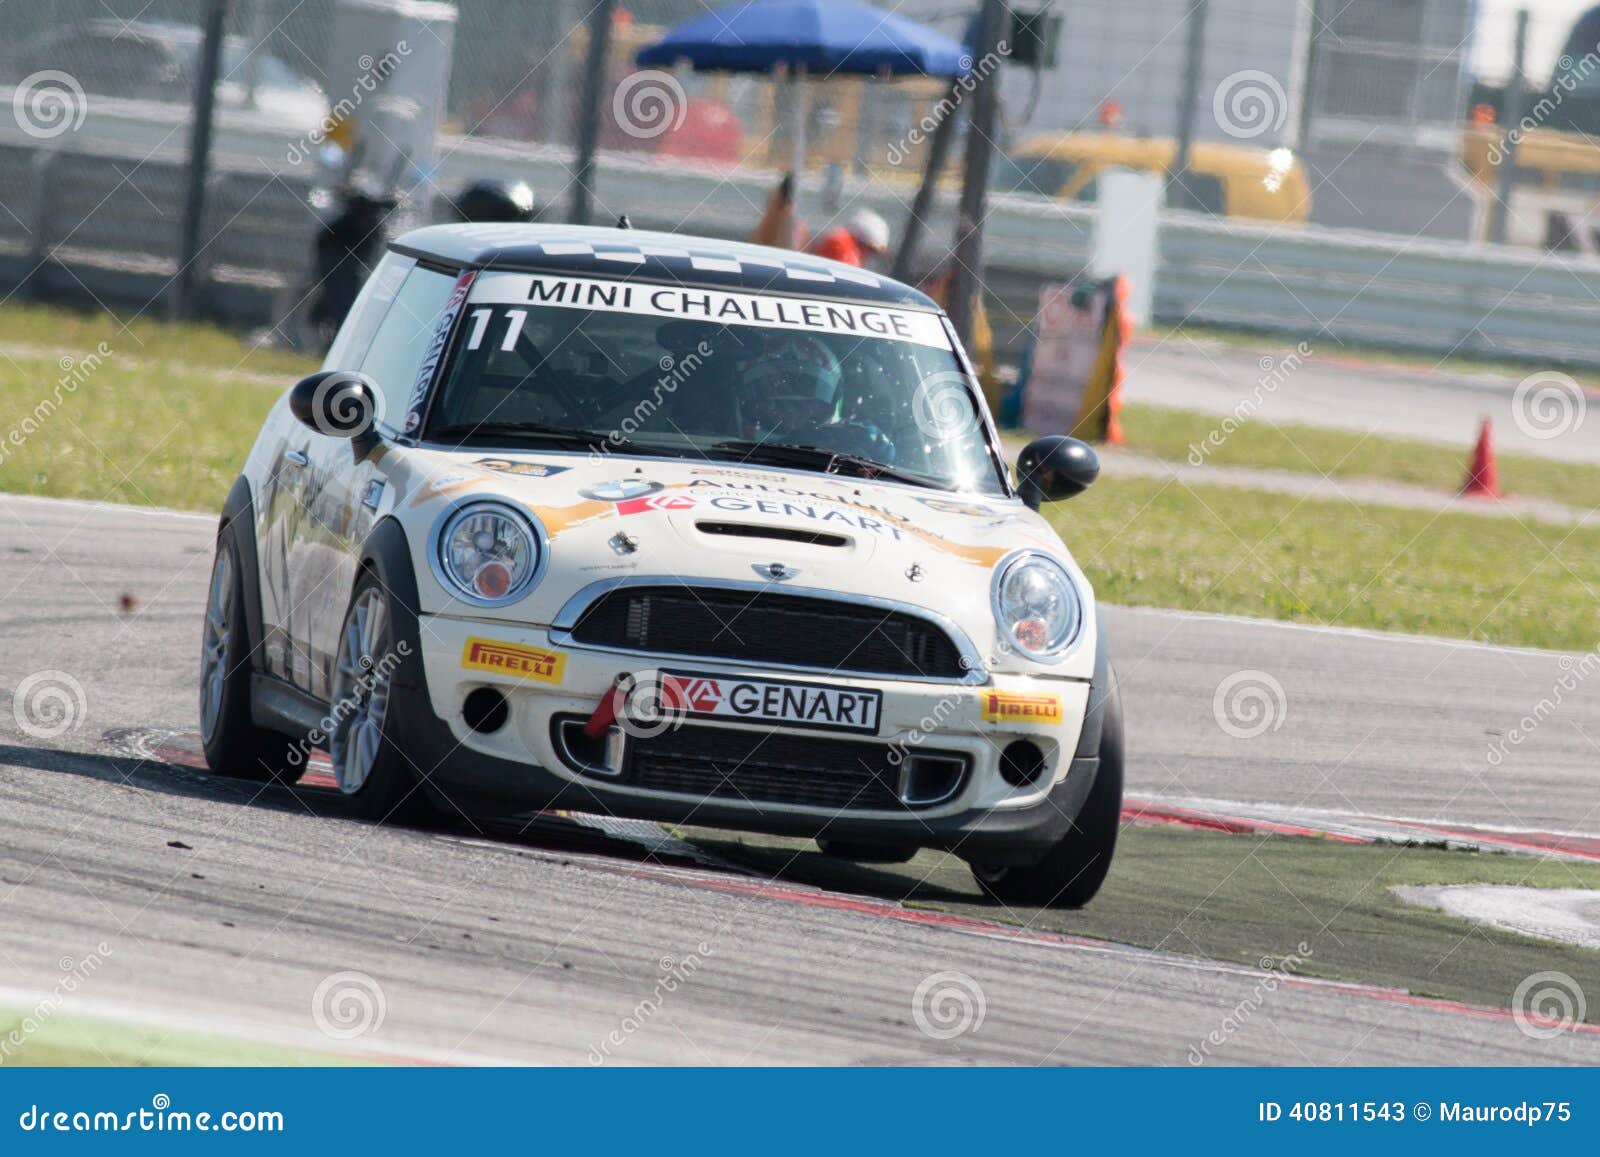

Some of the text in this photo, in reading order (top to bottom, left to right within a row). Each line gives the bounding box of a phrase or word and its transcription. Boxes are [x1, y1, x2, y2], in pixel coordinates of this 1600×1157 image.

[527, 279, 913, 338] MINI CHALLENGE
[467, 308, 529, 352] 11
[710, 497, 902, 541] GENART
[469, 642, 557, 677] PIRELLI
[730, 684, 874, 725] GENART
[987, 694, 1057, 717] PIRELLI
